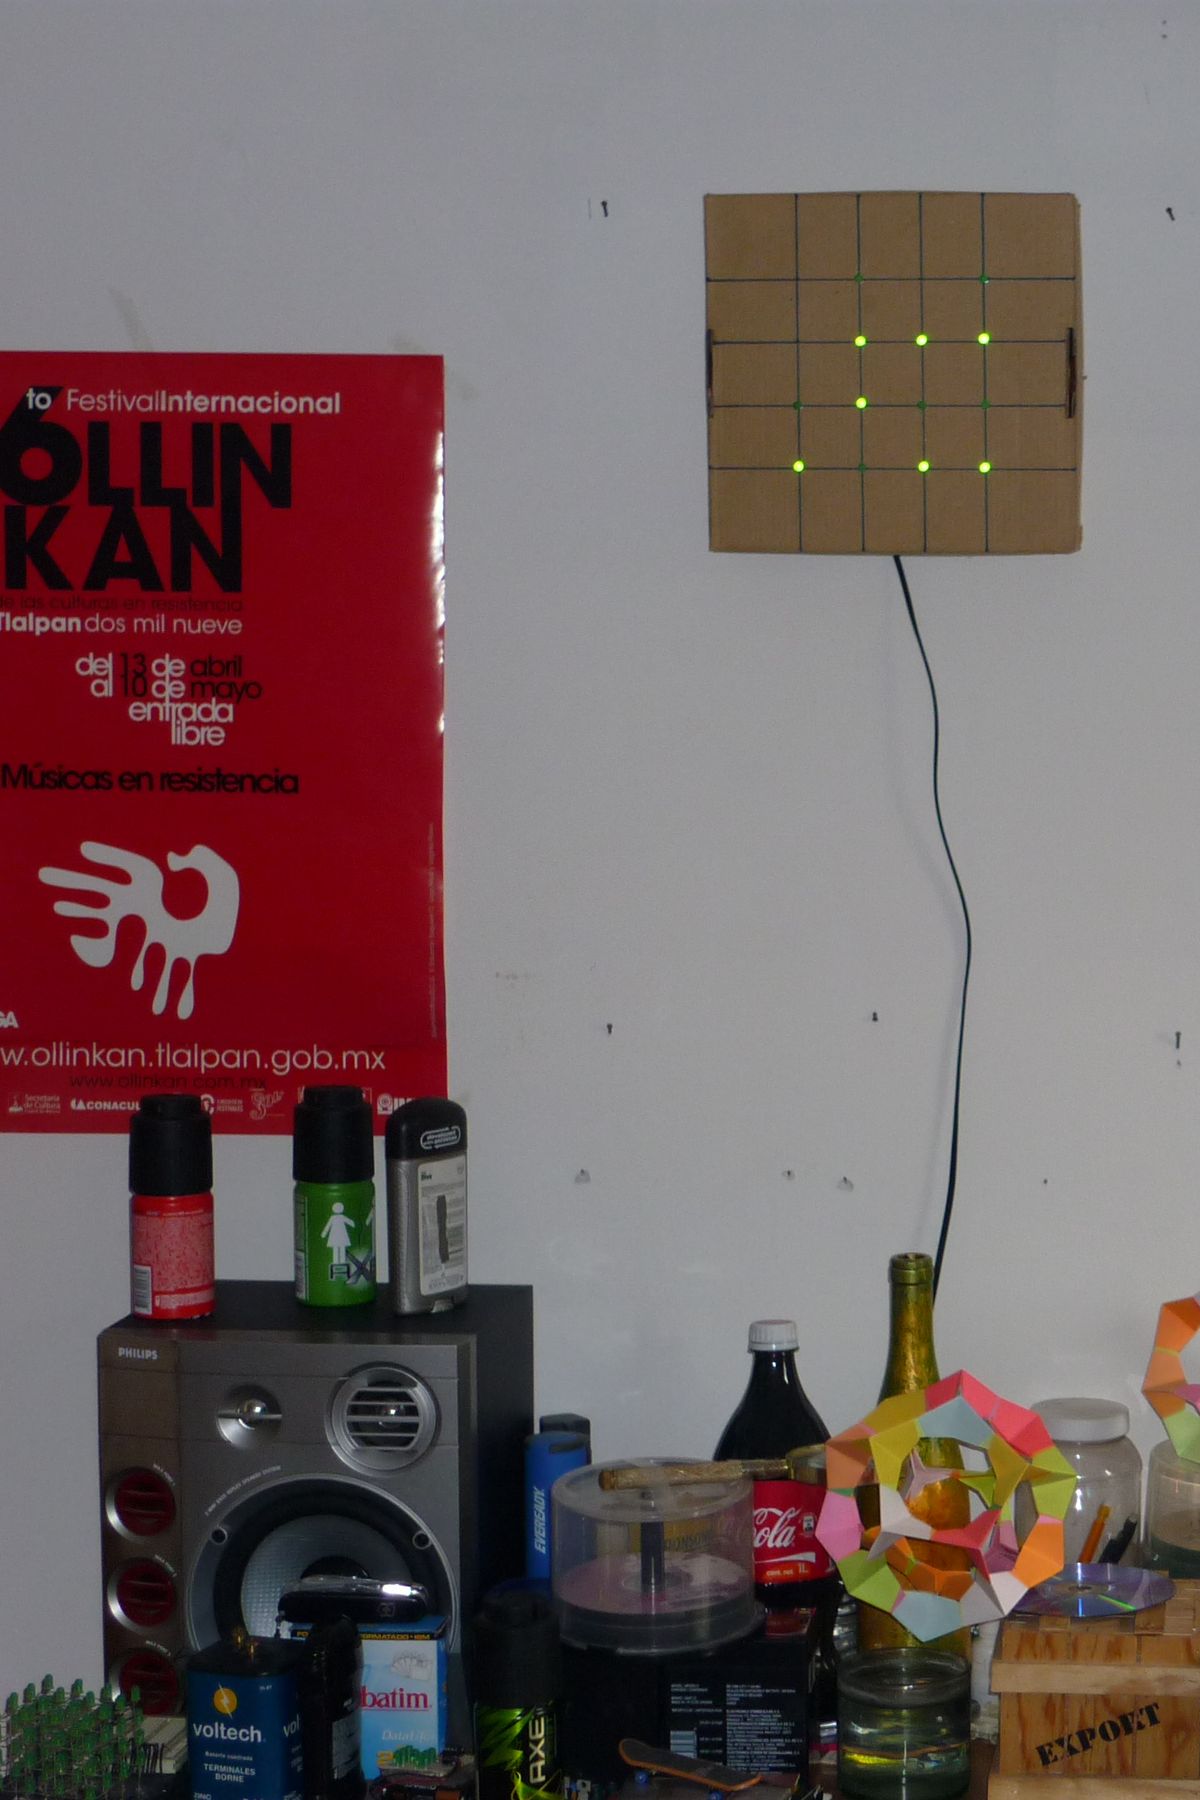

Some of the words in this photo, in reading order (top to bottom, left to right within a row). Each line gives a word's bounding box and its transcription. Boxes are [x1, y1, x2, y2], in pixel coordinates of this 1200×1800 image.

[4, 504, 242, 593] KAN
[84, 613, 126, 634] dos
[133, 613, 165, 633] mil
[173, 617, 243, 635] nueve
[75, 652, 113, 676] del
[120, 653, 147, 676] 13
[151, 653, 186, 677] de
[190, 655, 243, 678] abril
[90, 677, 113, 697] al
[151, 675, 186, 698] de
[190, 680, 262, 703] mayo
[128, 697, 234, 723] entrada
[171, 720, 226, 746] libre
[1, 762, 113, 791] Músicas
[118, 770, 154, 791] en
[160, 767, 299, 794] resistencia
[118, 1346, 158, 1360] PHILIPS
[193, 1722, 262, 1743] voltech
[1035, 1702, 1161, 1766] EXPORT
[529, 1716, 546, 1784] AXE
[204, 1763, 256, 1776] TERMINALES
[215, 1773, 244, 1783] BORNE
